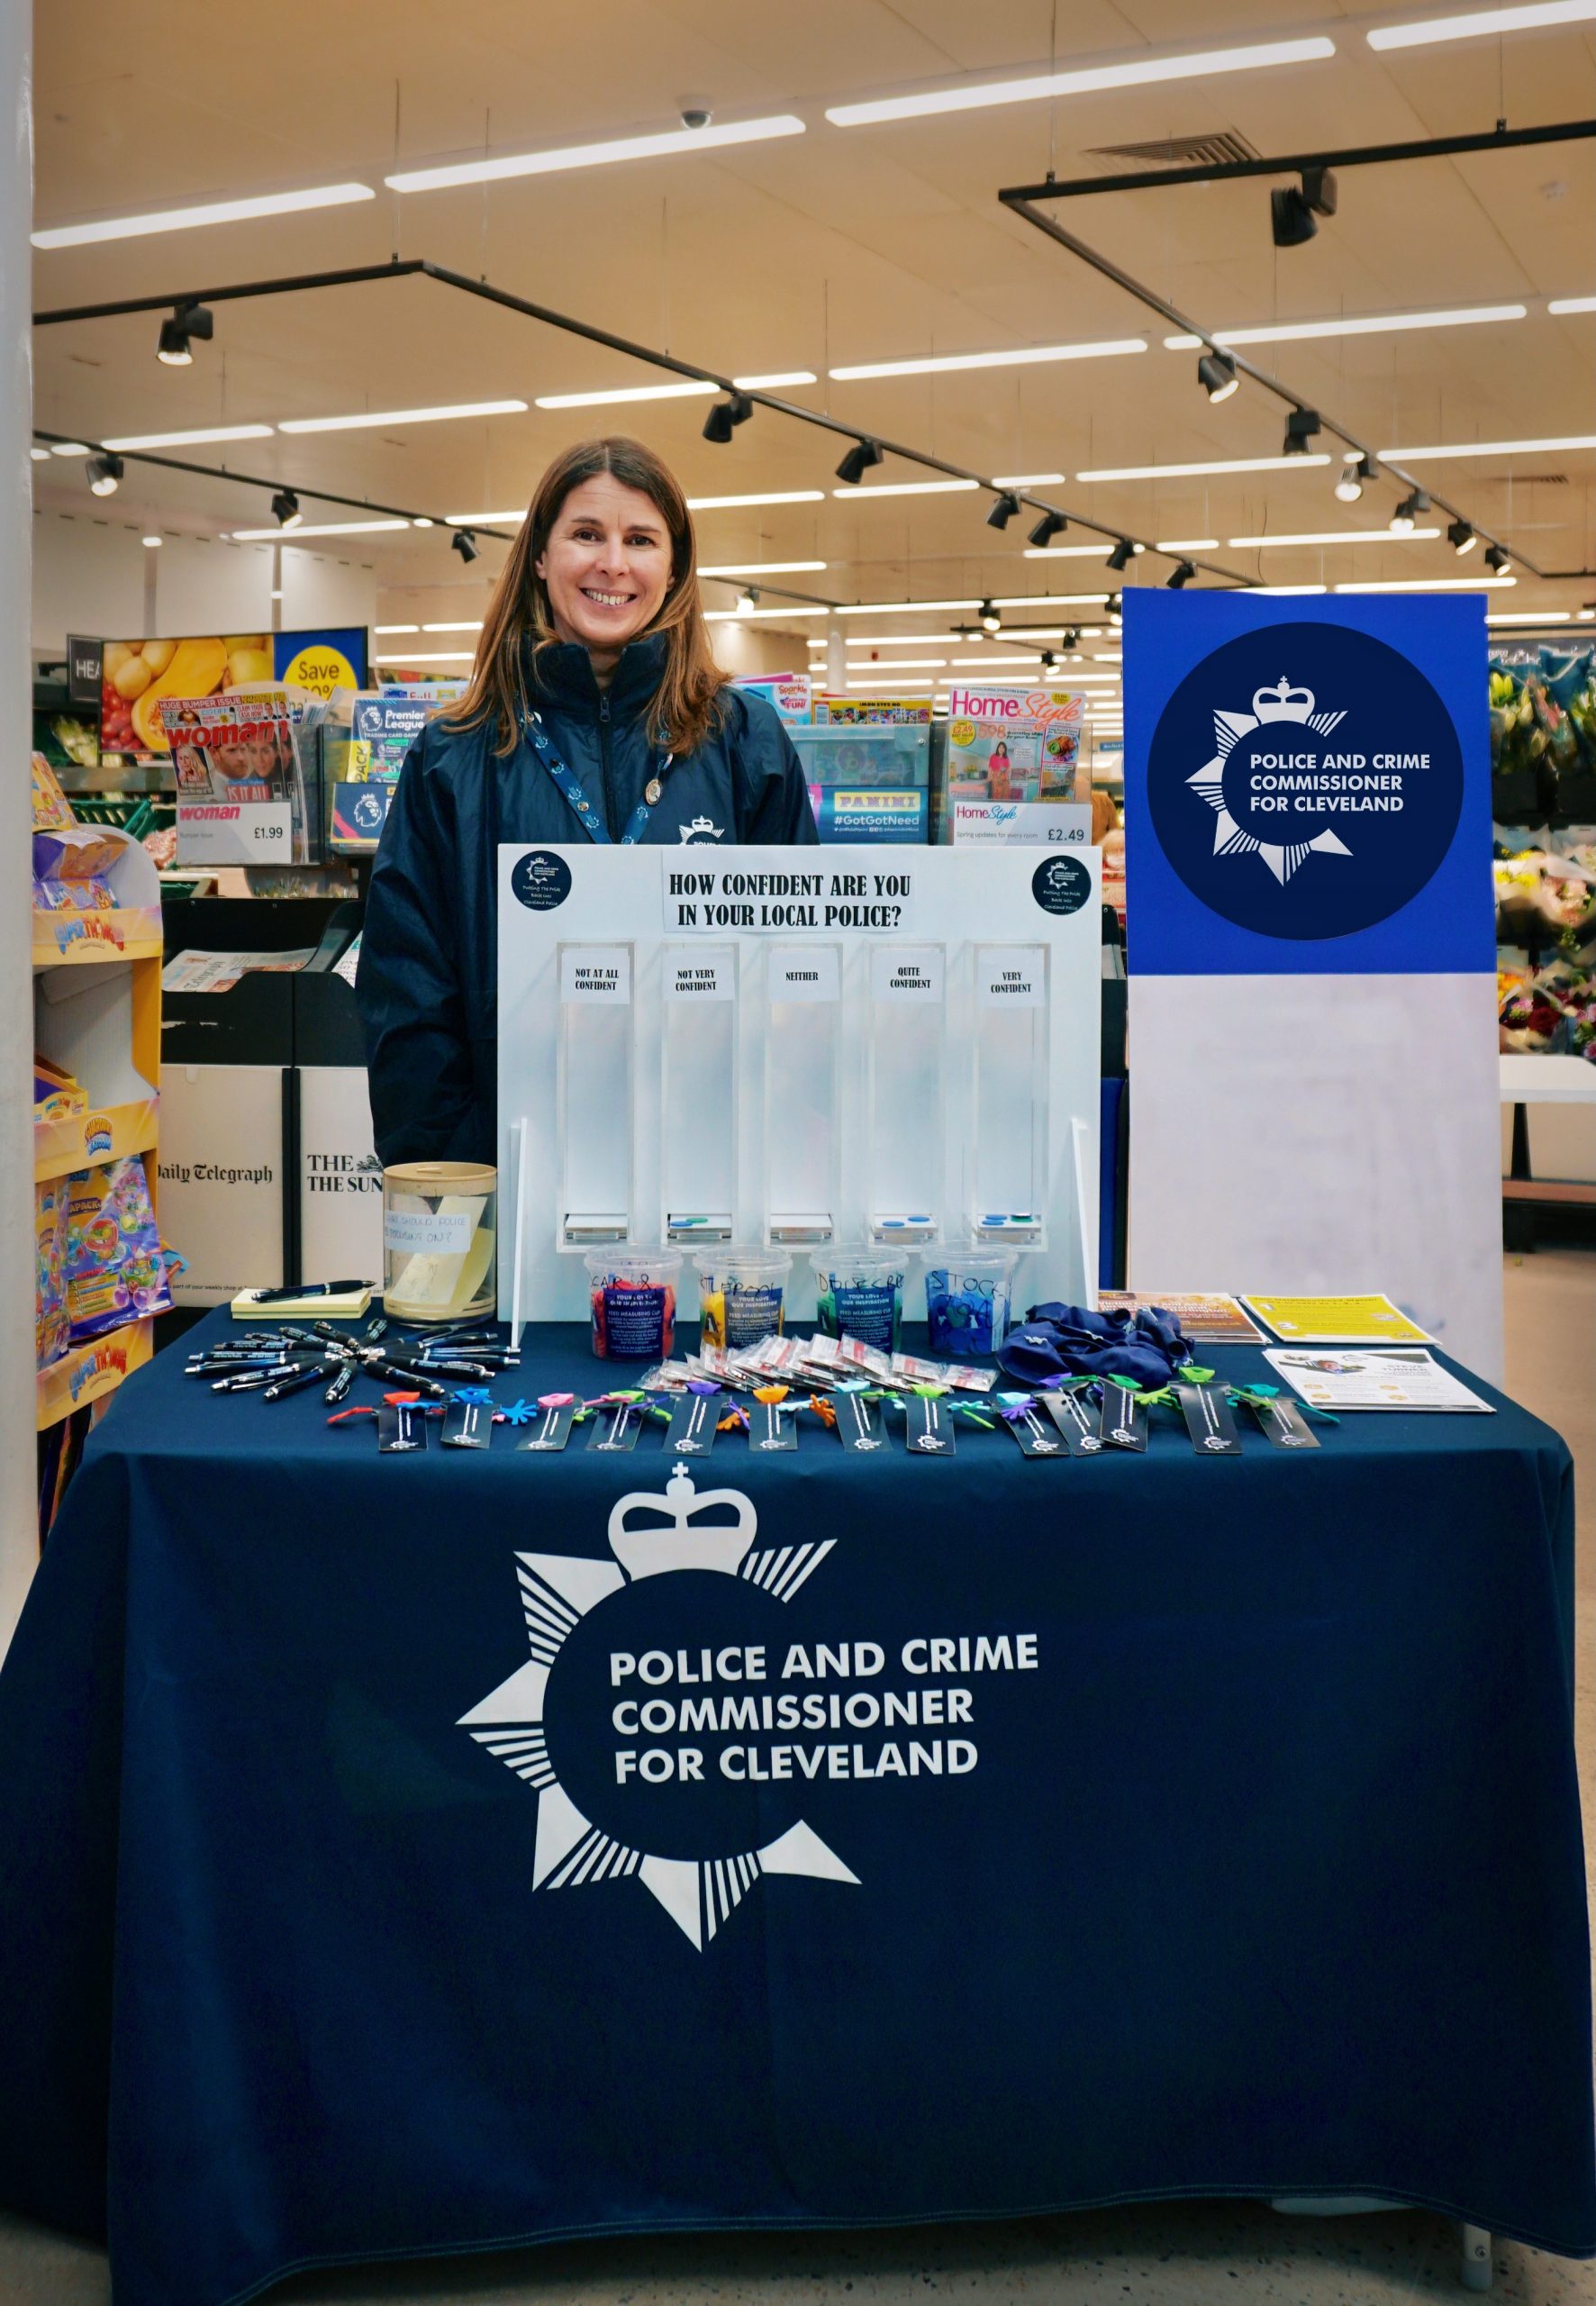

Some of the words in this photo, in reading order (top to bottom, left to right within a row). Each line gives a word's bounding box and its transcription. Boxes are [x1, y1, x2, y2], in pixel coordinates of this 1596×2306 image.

[299, 661, 340, 680] Save
[159, 702, 181, 710] HUGE
[182, 698, 216, 709] BUMPER
[217, 696, 241, 706] ISSUE
[385, 711, 425, 721] Premier
[952, 690, 1019, 717] Home
[1017, 693, 1082, 731] Style
[385, 721, 424, 731] League
[166, 721, 275, 748] woman
[355, 746, 367, 782] PACK
[1251, 754, 1316, 768] POLICE
[1322, 755, 1365, 768] AND
[1373, 754, 1429, 768] CRIME
[1250, 776, 1401, 790] COMMISSIONER
[839, 796, 916, 808] PANINI
[1251, 797, 1288, 811] FOR
[1294, 796, 1403, 811] CLEVELAND
[180, 806, 240, 821] woman
[834, 815, 920, 825] #GotGotNeed
[957, 806, 989, 820] Home
[988, 804, 1017, 826] Style
[254, 827, 283, 840] £1.99
[957, 831, 974, 840] Spring
[975, 831, 997, 840] updates
[1047, 829, 1084, 841] £2.49
[670, 875, 715, 894] HOW
[722, 875, 823, 895] CONFIDENT
[830, 876, 866, 895] ARE
[874, 876, 910, 896] YOU
[678, 905, 696, 925] IN
[704, 904, 754, 925] YOUR
[761, 905, 818, 926] LOCAL
[825, 906, 901, 926] POLICE?
[576, 969, 590, 977] NOT
[594, 969, 603, 977] AT
[606, 969, 619, 978] ALL
[678, 970, 692, 979] NOT
[695, 970, 714, 978] VERY
[786, 972, 818, 980] NEITHER
[898, 967, 920, 976] QUITE
[1002, 972, 1020, 980] VERY
[576, 981, 616, 990] CONFIDENT
[676, 982, 716, 991] CONFIDENT
[891, 979, 930, 988] CONFIDENT
[991, 984, 1030, 993] CONFIDENT
[307, 1155, 353, 1171] THE
[194, 1164, 272, 1184] Telegraph
[307, 1176, 343, 1192] THE
[611, 1647, 766, 1685] POLICE
[782, 1642, 884, 1678] AND
[902, 1634, 1038, 1674] CRIME
[612, 1689, 974, 1734] COMMISSIONER
[616, 1748, 704, 1784] FOR
[720, 1740, 977, 1780] CLEVELAND
